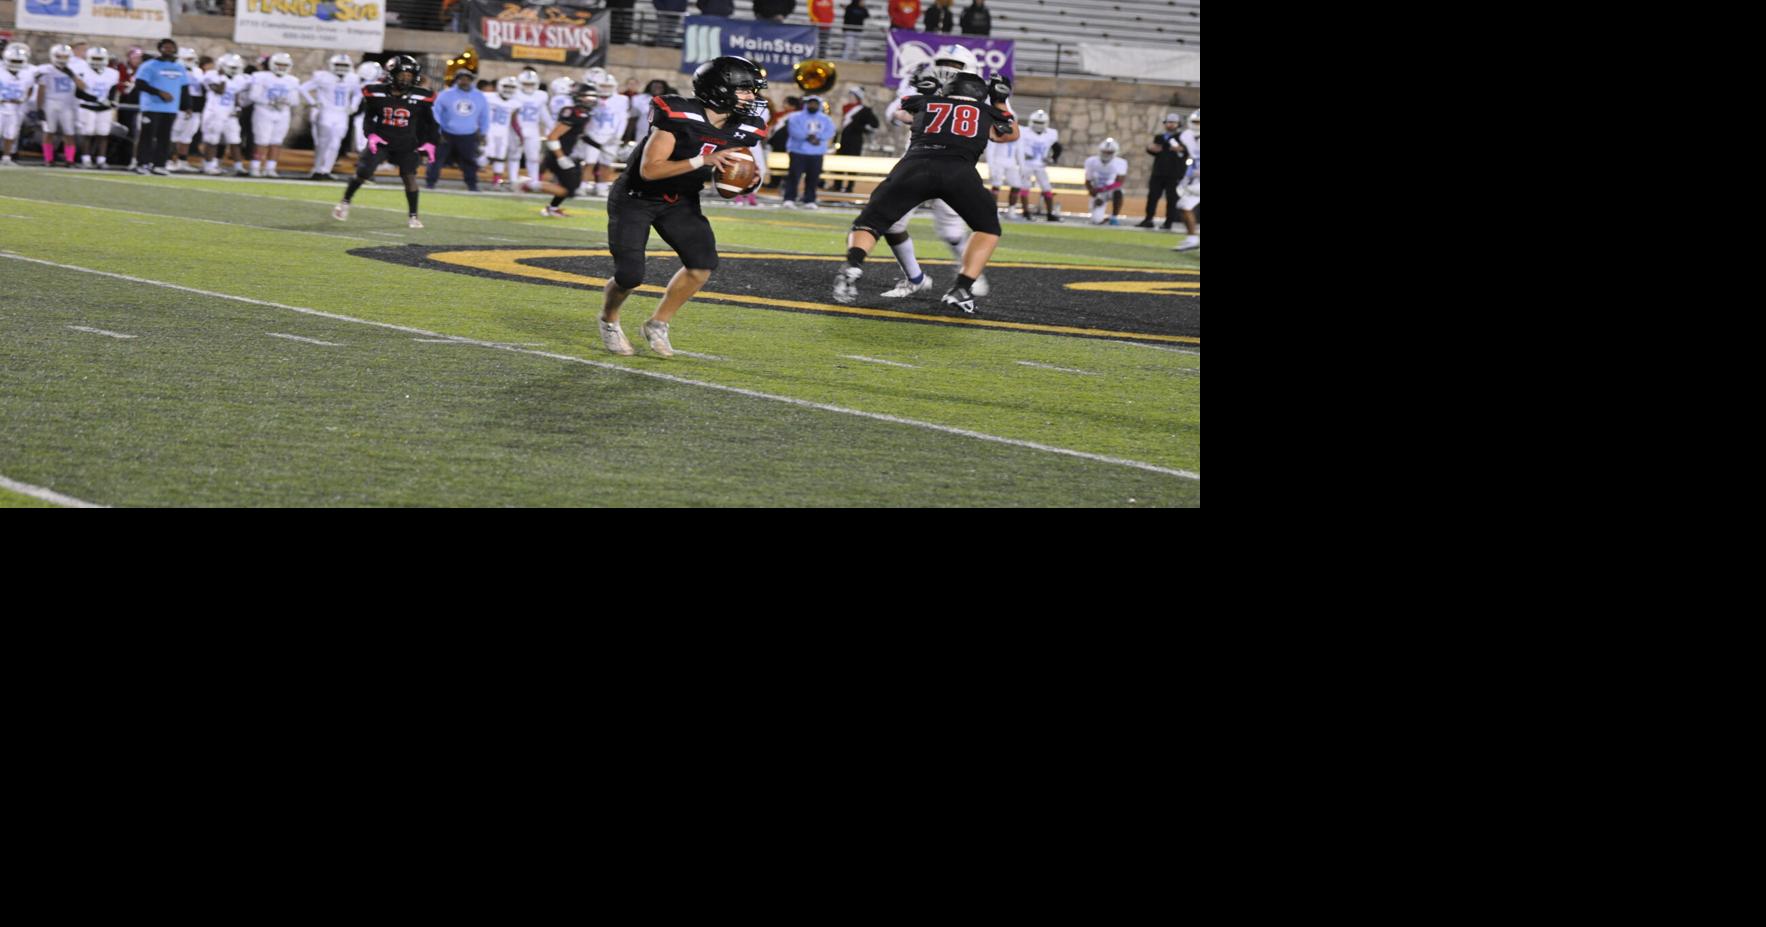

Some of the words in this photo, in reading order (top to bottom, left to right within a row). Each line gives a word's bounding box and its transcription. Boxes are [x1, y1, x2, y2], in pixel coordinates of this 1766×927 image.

[485, 19, 544, 49] BILLY
[545, 25, 594, 56] SIMS
[729, 35, 815, 58] MainStay
[382, 106, 411, 128] 12
[924, 102, 981, 138] 78
